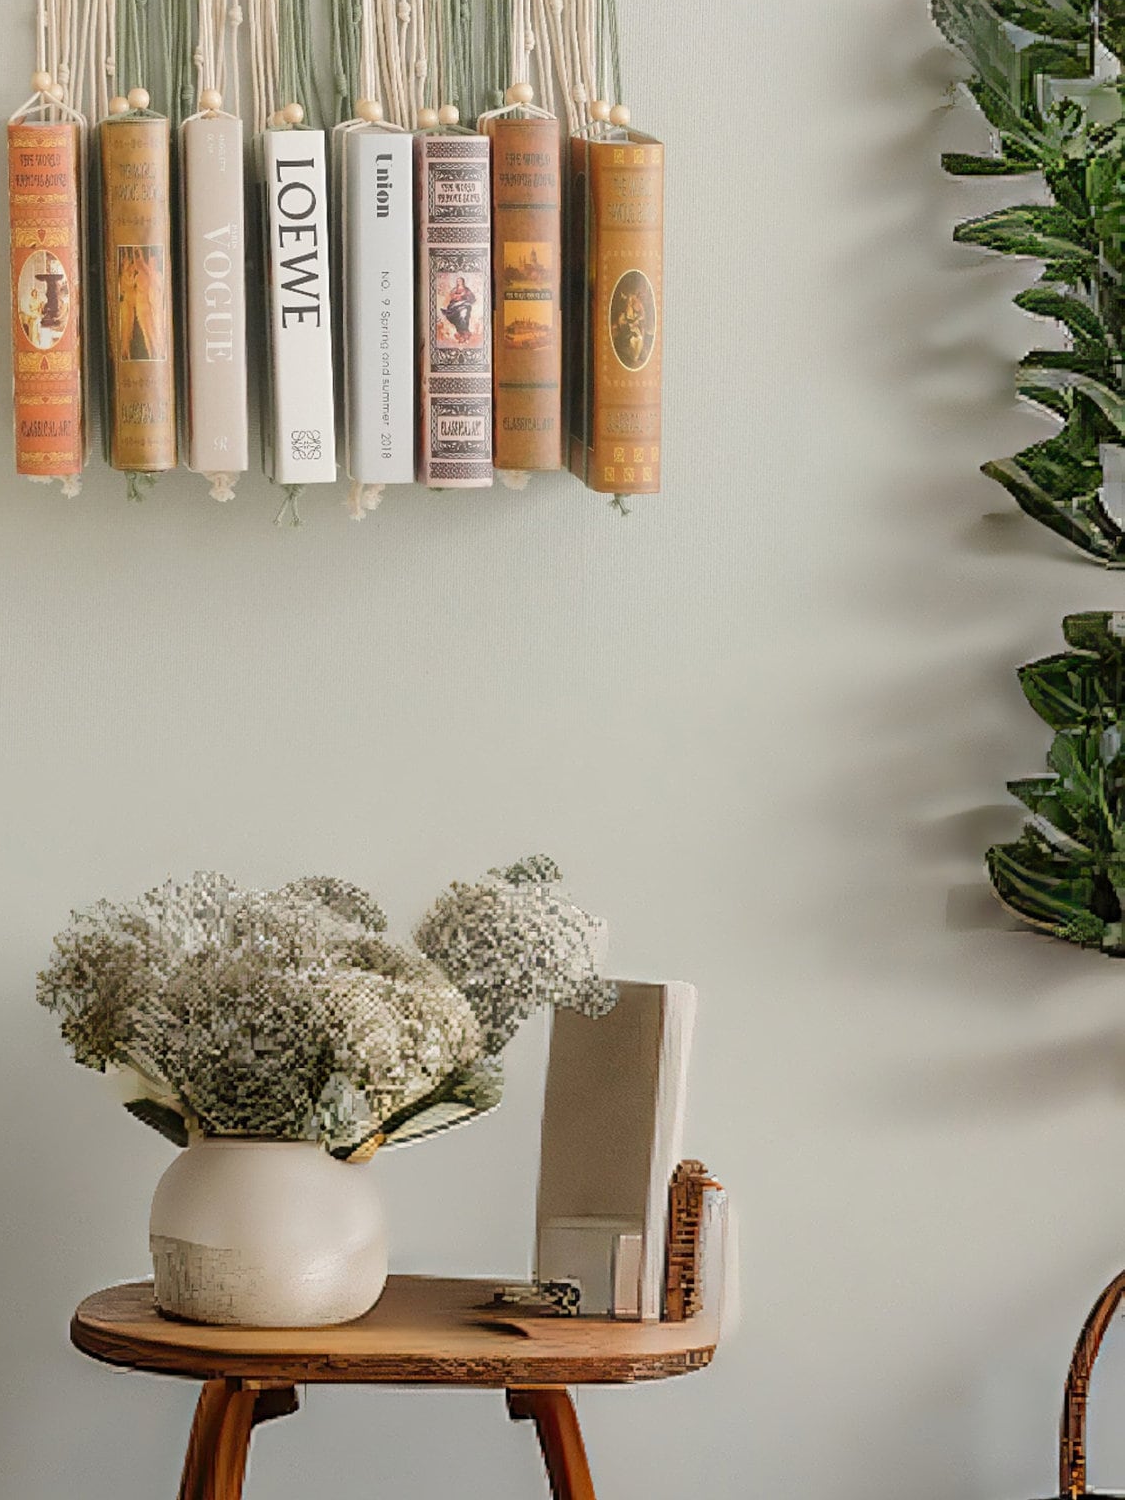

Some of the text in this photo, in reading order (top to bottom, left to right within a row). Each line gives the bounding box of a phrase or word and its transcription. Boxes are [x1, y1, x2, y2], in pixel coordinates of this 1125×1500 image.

[375, 153, 393, 218] Union
[276, 158, 321, 329] LOEWE
[203, 222, 234, 363] VOGUE
[381, 298, 391, 306] 9
[379, 310, 391, 350] Spring
[381, 351, 392, 376] and
[381, 378, 391, 426] summer
[380, 433, 392, 460] 2018
